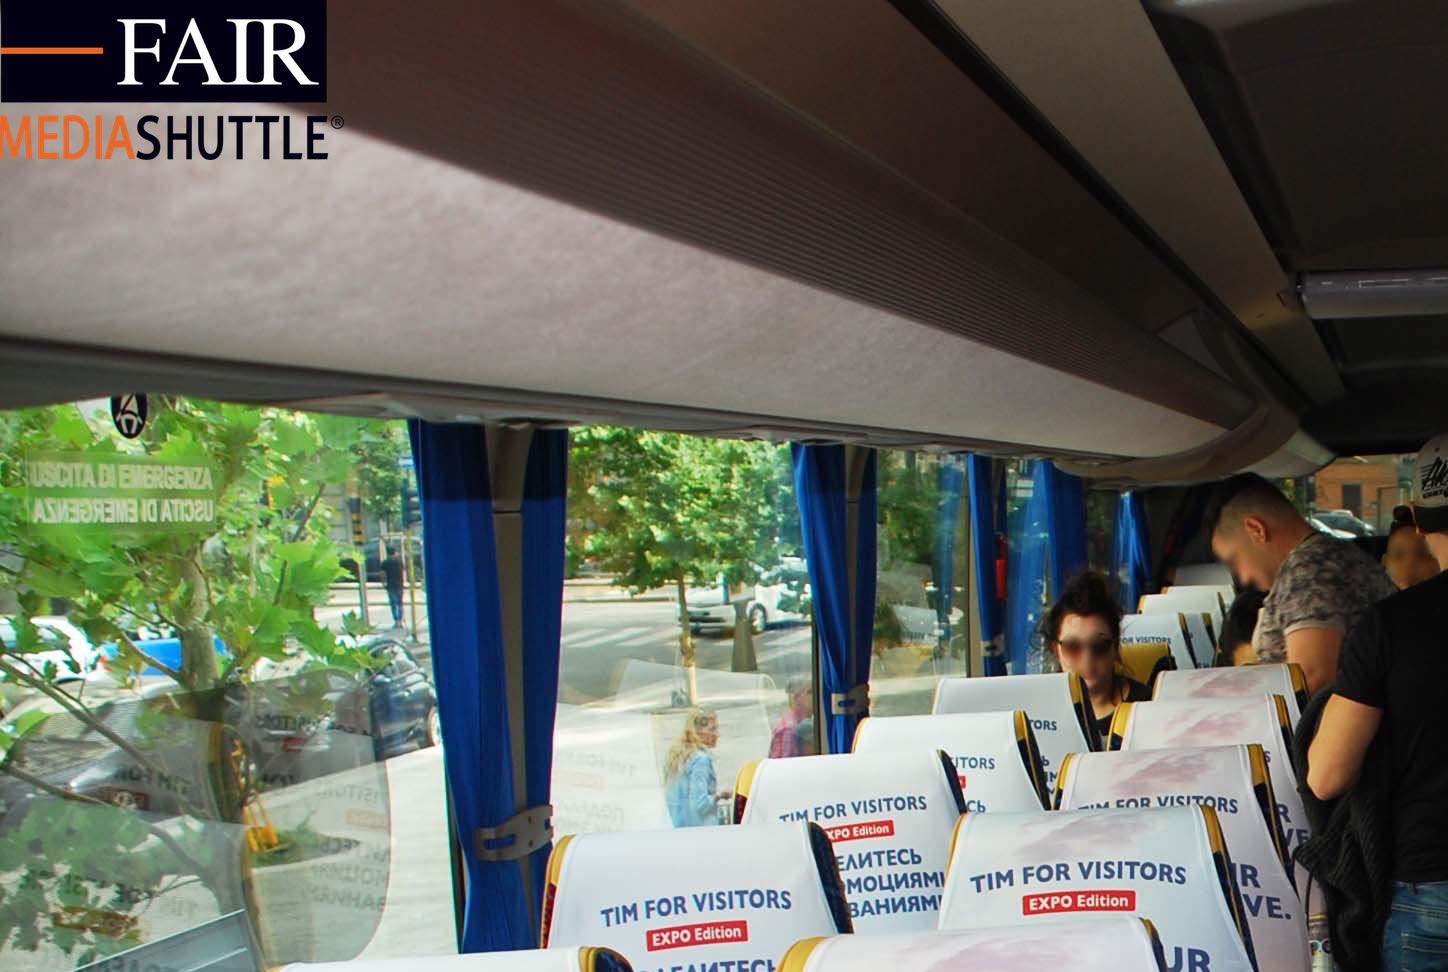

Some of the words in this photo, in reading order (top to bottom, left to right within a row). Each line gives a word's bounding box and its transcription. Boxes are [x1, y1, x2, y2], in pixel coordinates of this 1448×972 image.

[30, 463, 96, 488] USCITA
[100, 464, 116, 489] DI
[119, 464, 213, 489] EMERGENZA
[1028, 720, 1057, 731] TORS
[814, 803, 847, 821] FOR
[851, 796, 928, 816] VISITORS
[1157, 795, 1238, 814] VISITORS
[827, 827, 850, 840] XPO
[853, 824, 890, 837] Edition
[837, 848, 922, 872] ЕЛИТЕСЬ
[970, 868, 1014, 893] TIM
[1022, 863, 1071, 886] FOR
[1078, 860, 1187, 886] VISITORS
[601, 902, 638, 927] TIM
[645, 896, 688, 919] FOR
[692, 889, 792, 913] VISITORS
[1028, 895, 1073, 911] EXPO
[1076, 893, 1130, 909] Edition
[652, 929, 691, 947] EXPO
[695, 926, 742, 942] Edition
